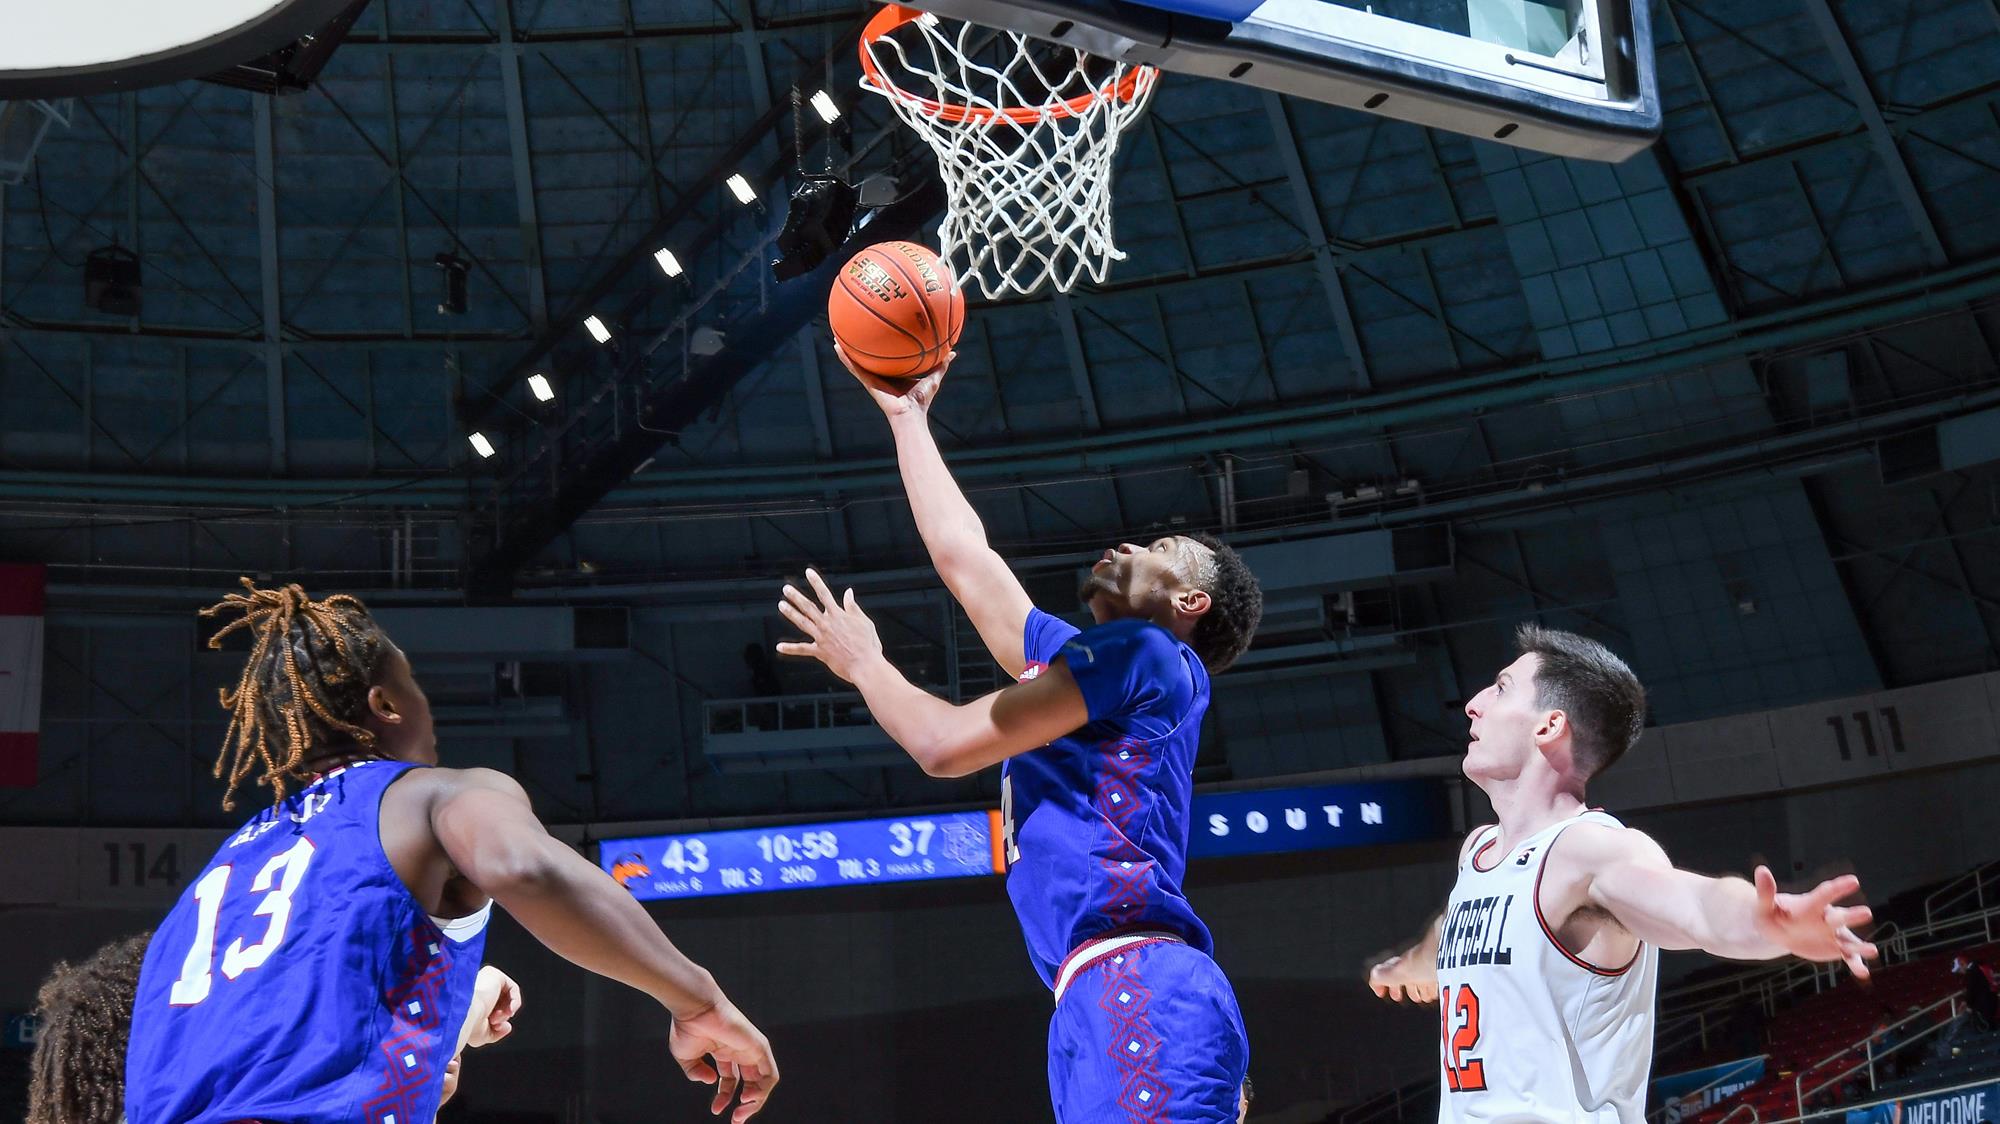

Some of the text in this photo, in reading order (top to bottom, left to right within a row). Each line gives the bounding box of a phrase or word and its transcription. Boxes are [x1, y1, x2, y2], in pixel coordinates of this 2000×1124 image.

[853, 254, 909, 300] LEGACY
[881, 242, 943, 294] ALDING
[1826, 706, 1906, 760] 111
[661, 838, 710, 874] 43
[756, 830, 839, 863] 10:58
[888, 820, 936, 857] 37
[104, 842, 181, 887] 114
[169, 834, 318, 1008] 13
[1436, 894, 1515, 969] AMPBELL
[1442, 983, 1488, 1093] 12
[1907, 1092, 1986, 1124] WELCOME
